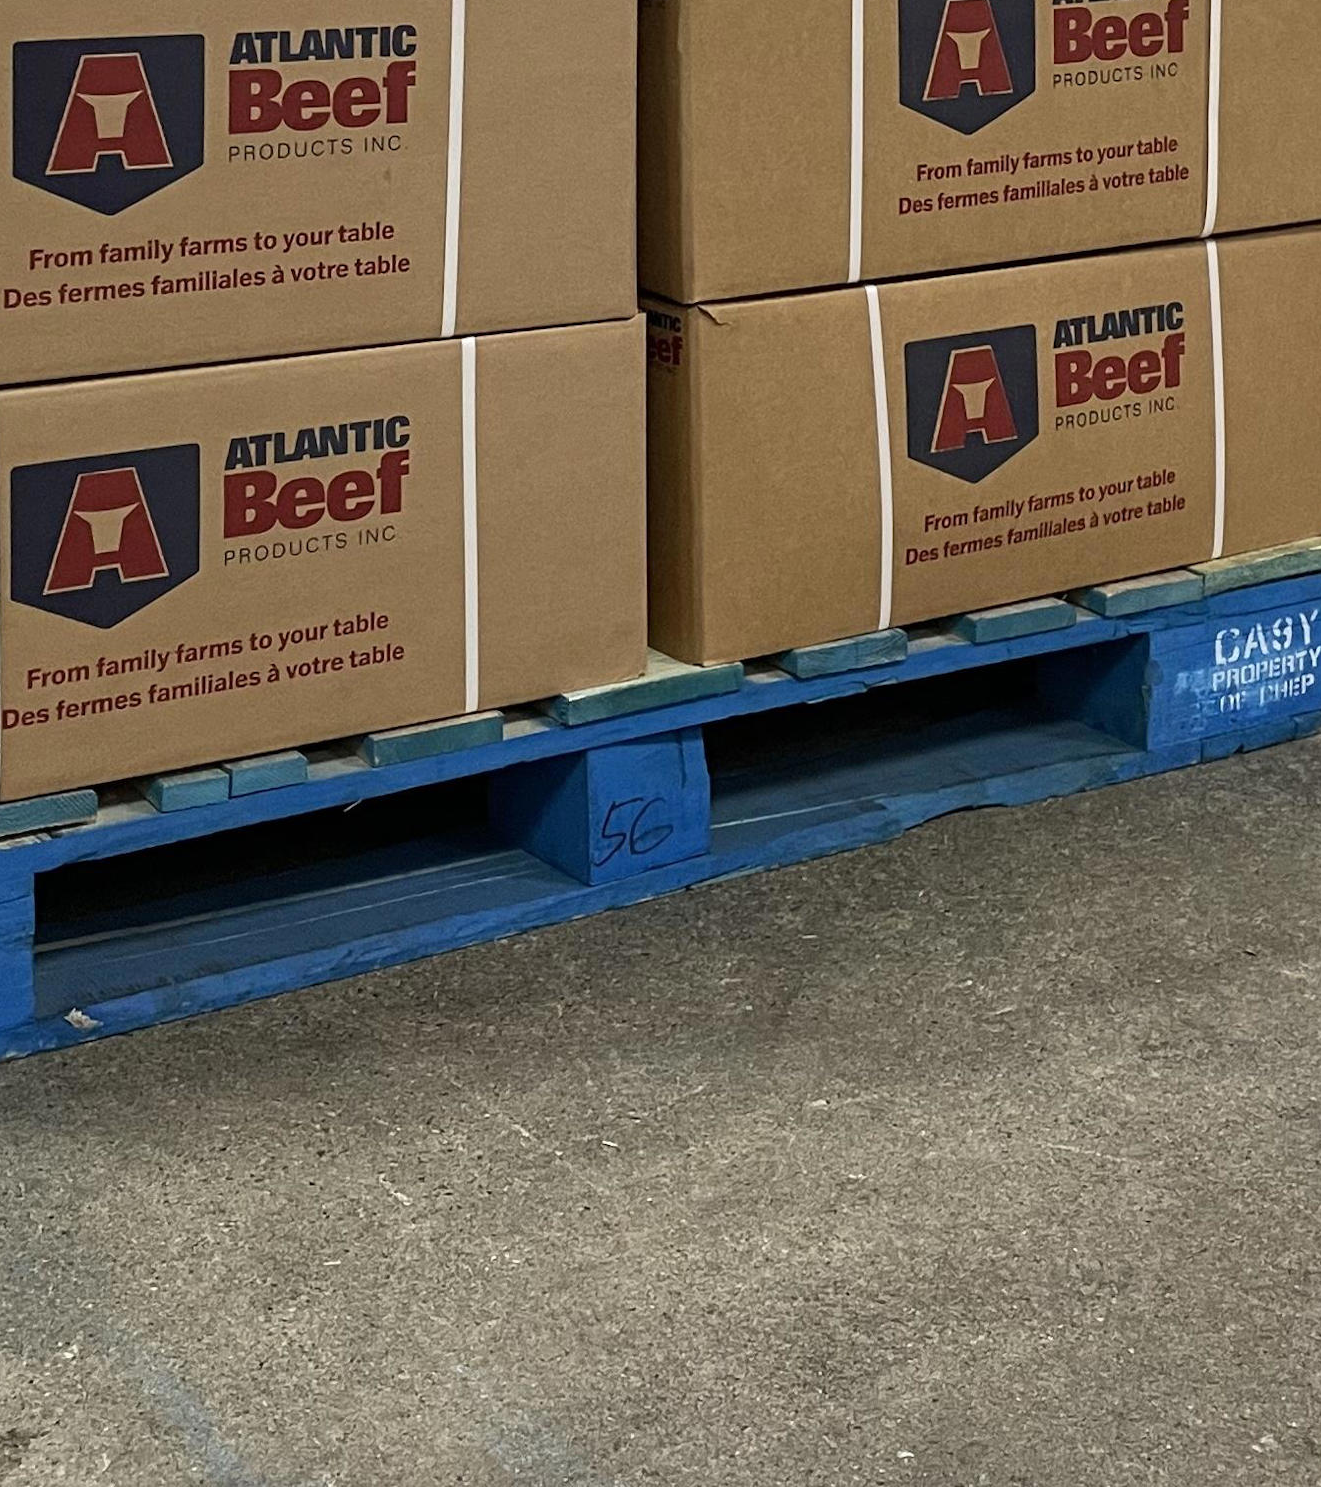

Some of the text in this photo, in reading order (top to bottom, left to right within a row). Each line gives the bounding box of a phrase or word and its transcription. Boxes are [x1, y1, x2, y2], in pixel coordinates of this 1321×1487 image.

[229, 24, 417, 66] ATLANTIC
[228, 59, 417, 136] Beef
[1055, 65, 1145, 89] PRODUCTS
[229, 137, 354, 163] PRODUCTS
[915, 136, 1177, 182] From family farms to your table
[899, 164, 1190, 215] Des fermes familiales à votre table
[29, 220, 395, 271] From family farms to your table
[4, 254, 411, 309] Des fermes familiales à votre table
[1053, 302, 1184, 349] ATLANTIC
[1053, 331, 1185, 408] Beef
[1056, 401, 1143, 431] PRODUCTS
[224, 414, 411, 471] ATLANTIC
[223, 448, 411, 540] Beef
[224, 531, 348, 567] PRODUCTS
[1212, 645, 1321, 692] PROPERTY
[592, 797, 675, 867] 56
